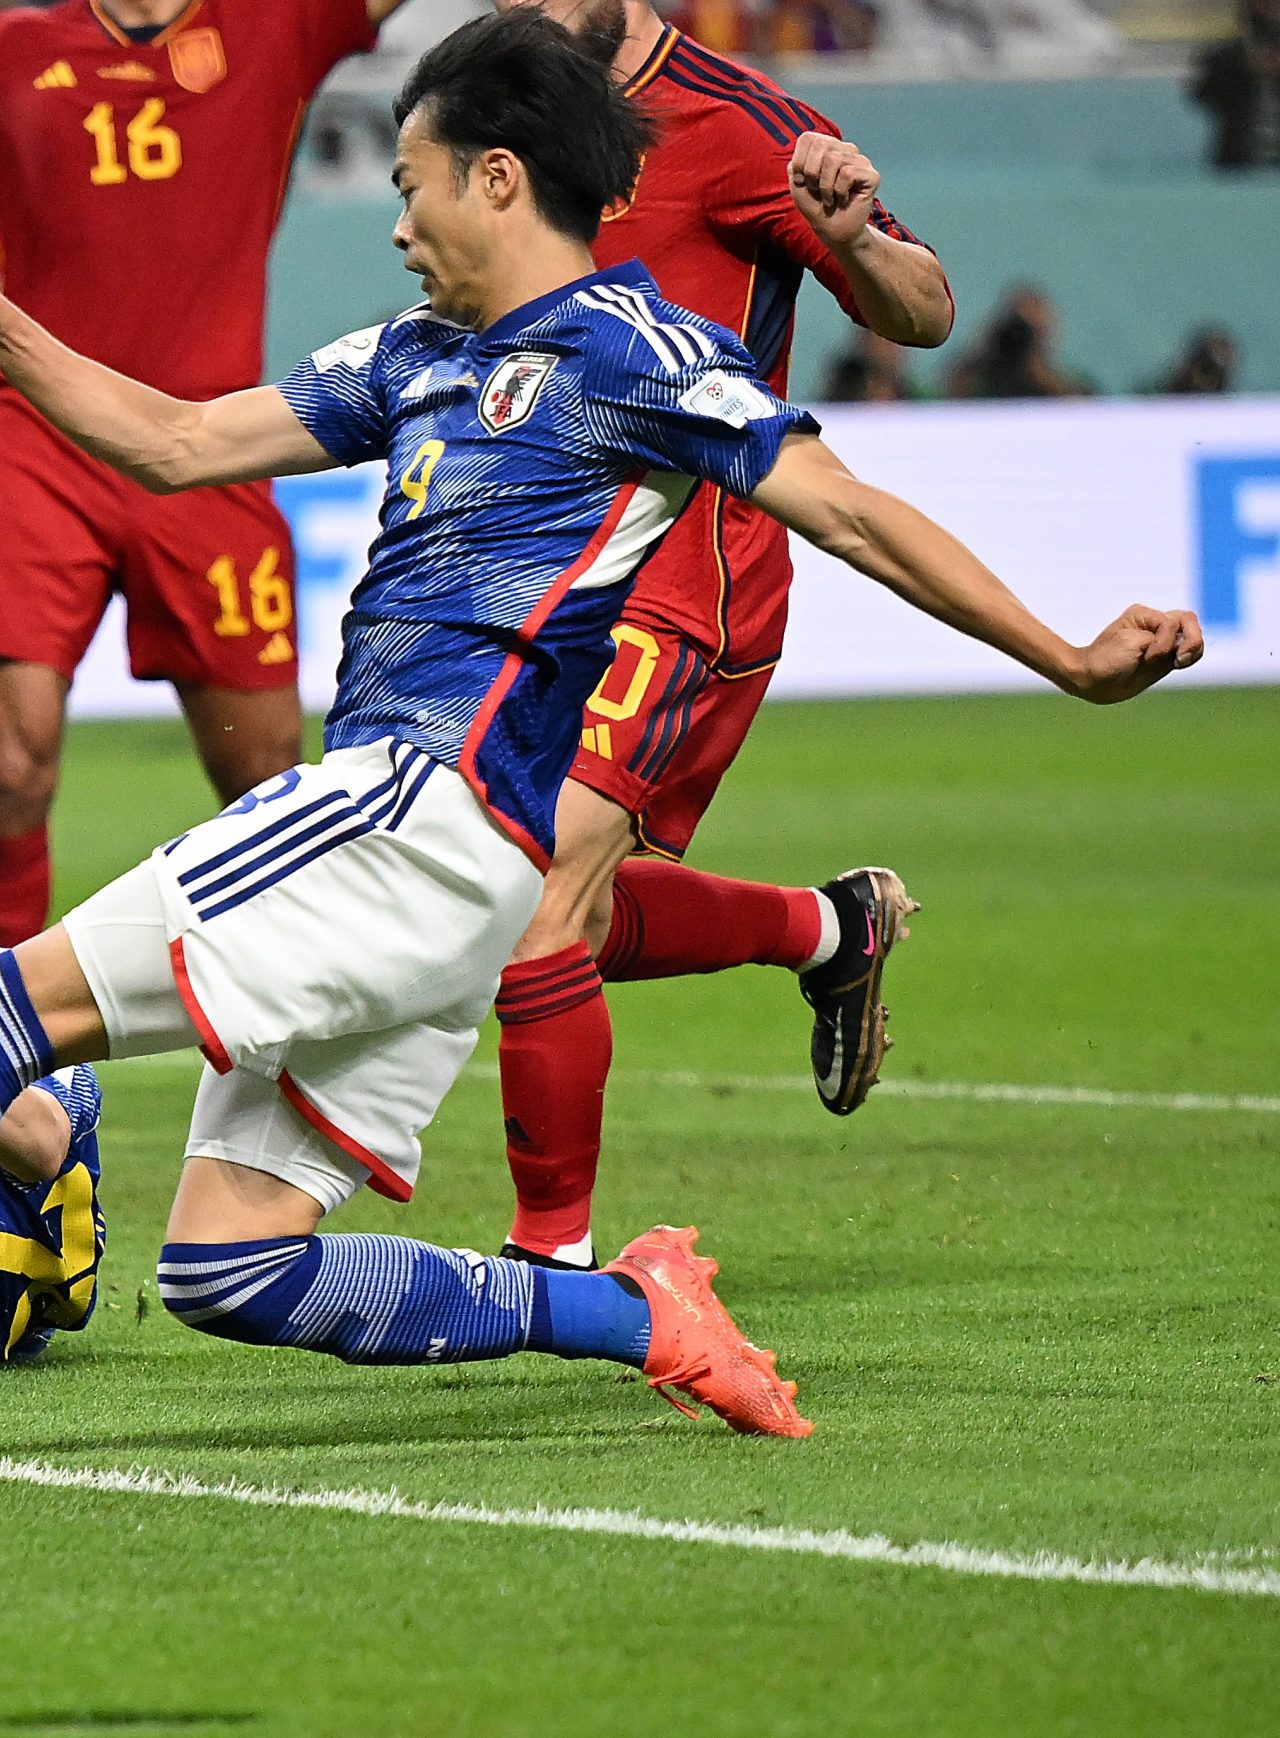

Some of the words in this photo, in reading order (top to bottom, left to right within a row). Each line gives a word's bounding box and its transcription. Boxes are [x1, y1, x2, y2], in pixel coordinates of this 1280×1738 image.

[83, 98, 181, 184] 16
[400, 439, 446, 520] 9
[206, 545, 292, 635] 16
